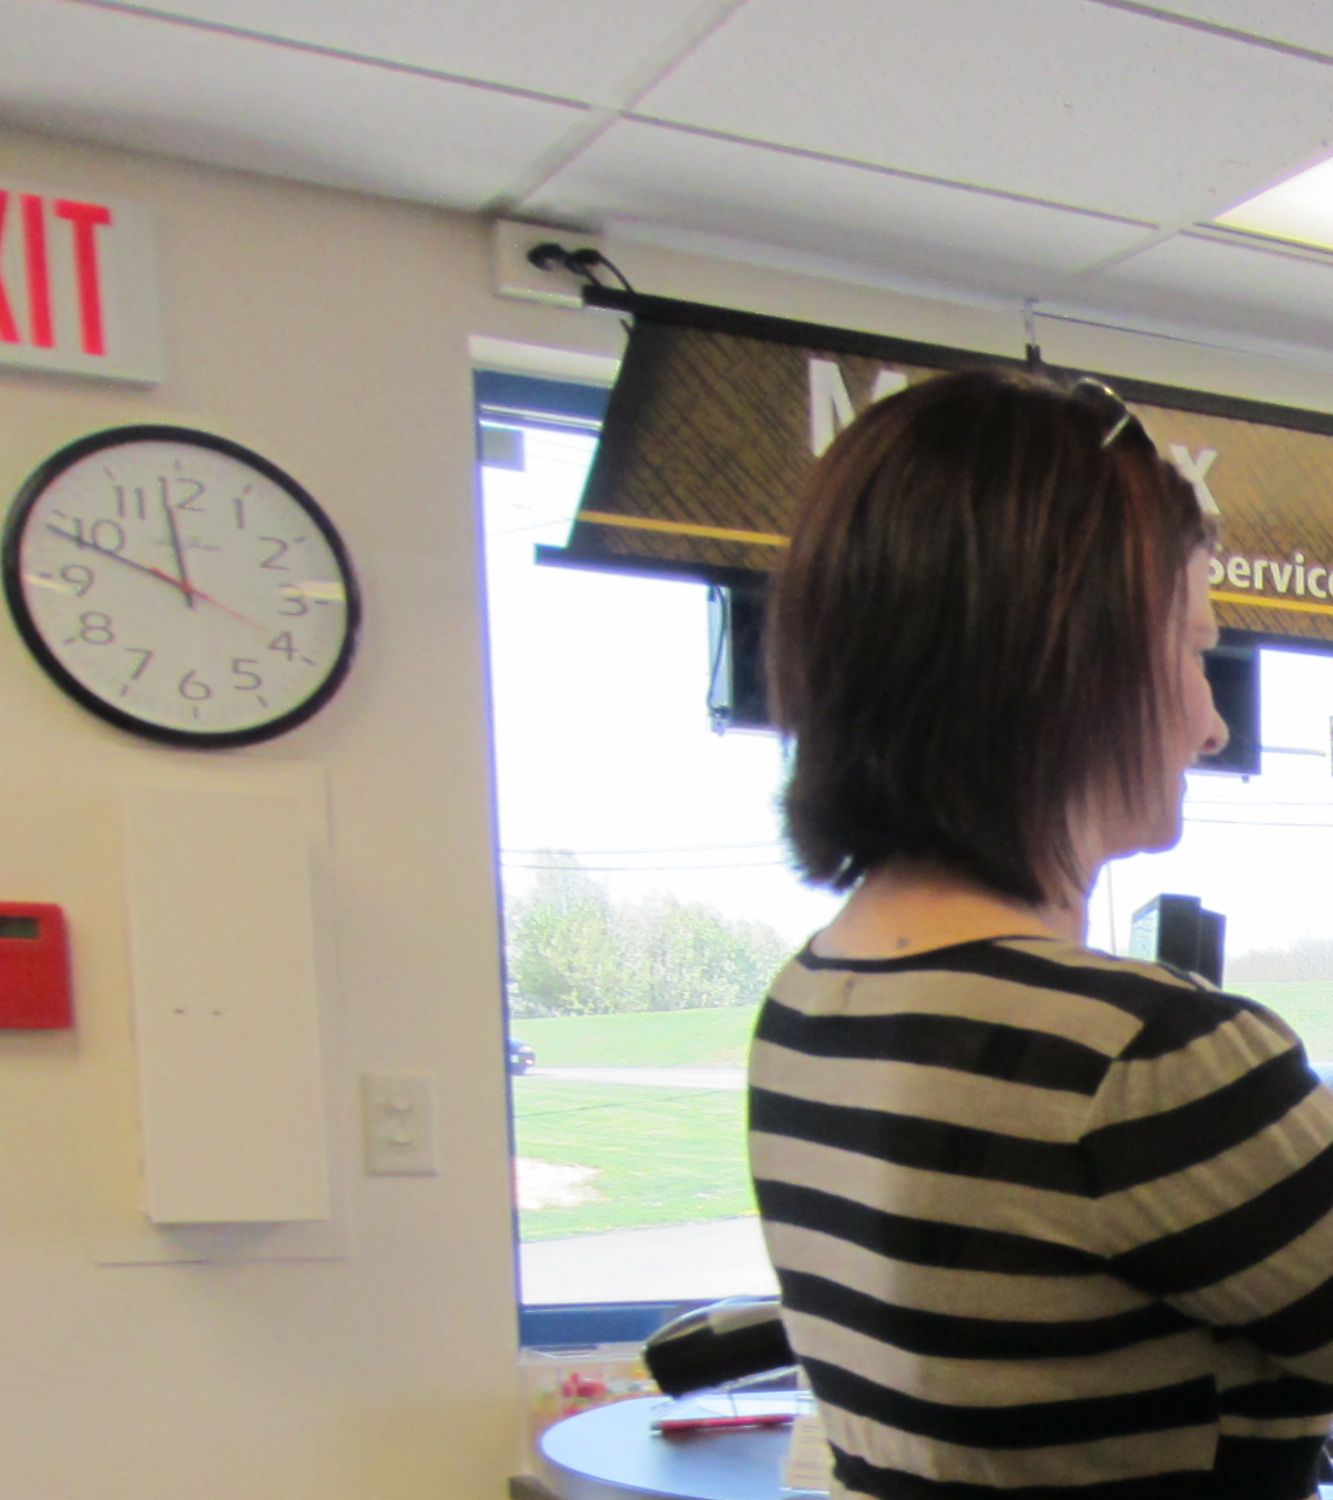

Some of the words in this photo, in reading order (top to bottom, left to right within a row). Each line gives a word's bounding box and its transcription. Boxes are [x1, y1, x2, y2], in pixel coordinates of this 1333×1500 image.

[113, 486, 146, 519] 11
[233, 497, 245, 530] 1
[258, 536, 289, 570] 2
[59, 564, 95, 597] 9
[276, 583, 308, 616] 3
[79, 611, 115, 645] 8
[267, 631, 298, 661] 4
[123, 648, 153, 680] 7
[232, 658, 262, 691] 5
[179, 669, 212, 700] 6
